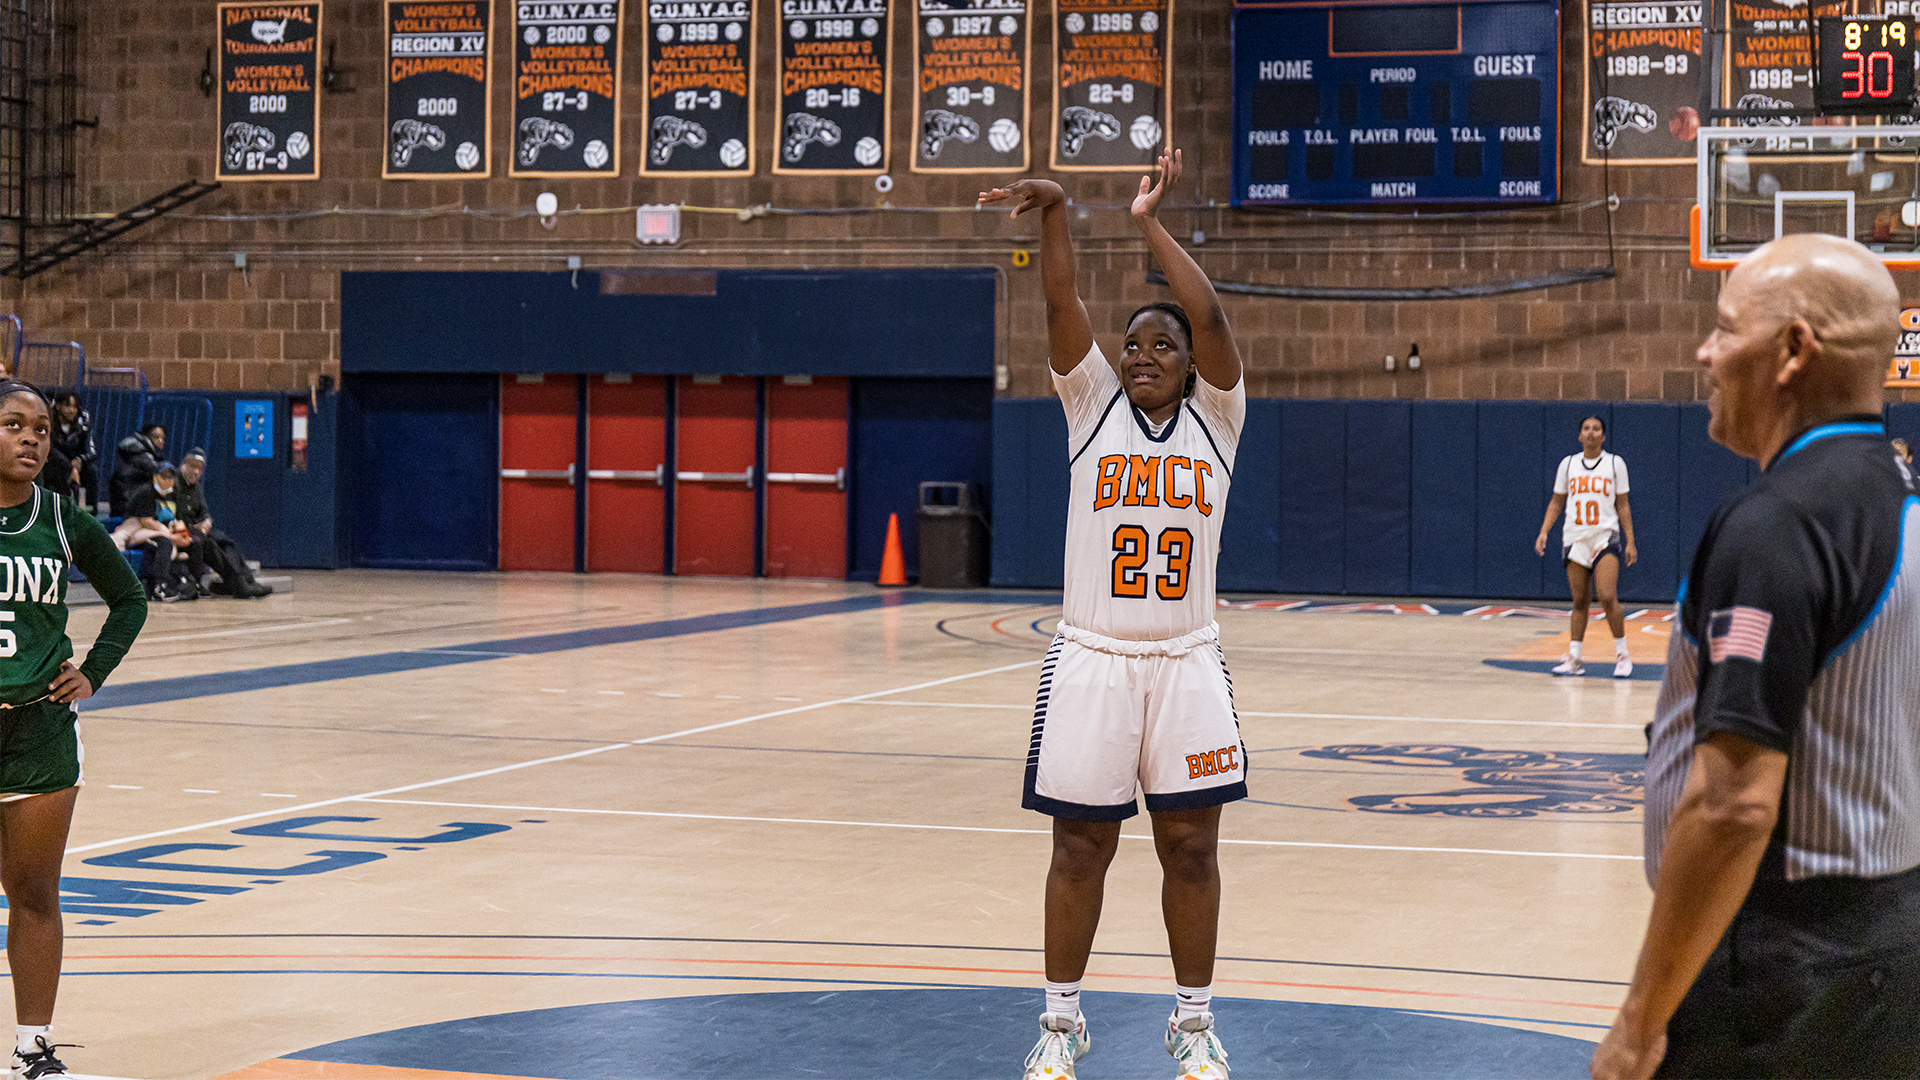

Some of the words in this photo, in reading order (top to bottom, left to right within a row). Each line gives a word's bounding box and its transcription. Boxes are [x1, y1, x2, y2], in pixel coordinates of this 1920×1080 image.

[226, 6, 313, 27] NATIONAL
[403, 4, 476, 18] WOMEN'S
[518, 4, 616, 19] C.U.N.Y.A.C.
[649, 2, 750, 18] C.U.N.Y.A.C.
[1592, 6, 1667, 24] REGION
[1675, 5, 1702, 22] XV
[394, 18, 483, 32] VOLLEYBALL
[814, 19, 854, 38] 1998
[951, 16, 992, 35] 1997
[1092, 13, 1133, 32] 1996
[546, 26, 587, 44] 2000
[680, 23, 718, 41] 1999
[226, 37, 314, 55] TOURNAMENT
[392, 37, 455, 52] REGION
[461, 36, 484, 51] XV
[661, 44, 737, 58] WOMEN'S
[794, 41, 872, 55] WOMEN'S
[932, 36, 1011, 51] WOMEN'S
[1592, 28, 1702, 58] CHAMPIONS
[530, 46, 604, 59] WOMEN'S
[923, 51, 1020, 66] VOLLEYBALL
[1062, 48, 1162, 61] VOLLEYBALL
[234, 65, 304, 78] WOMEN'S
[392, 58, 484, 83] CHAMPIONS
[521, 60, 612, 74] VOLLEYBALL
[652, 59, 745, 73] VOLLEYBALL
[785, 56, 881, 70] VOLLEYBALL
[1259, 60, 1313, 80] HOME
[1473, 55, 1536, 76] GUEST
[1607, 54, 1688, 76] 1992-93
[783, 69, 882, 95] CHAMPIONS
[920, 66, 1021, 92] CHAMPIONS
[1060, 62, 1162, 88] CHAMPIONS
[1370, 68, 1416, 83] PERIOD
[1841, 51, 1893, 98] 30
[227, 78, 311, 92] VOLLEYBALL
[518, 74, 613, 99] CHAMPIONS
[650, 73, 746, 99] CHAMPIONS
[249, 95, 287, 113] 2000
[543, 91, 588, 111] 27-3
[674, 90, 721, 110] 27-3
[805, 87, 861, 107] 20-16
[417, 98, 457, 116] 2000
[1248, 130, 1290, 146] FOULS
[1304, 129, 1339, 145] T.O.L.
[1350, 128, 1398, 144] PLAYER
[1405, 127, 1438, 143] FOUL
[1450, 127, 1486, 142] T.O.L.
[1500, 126, 1541, 142] FOULS
[246, 151, 288, 170] 27-3
[1248, 184, 1289, 199] SCORE
[1371, 182, 1416, 198] MATCH
[1499, 181, 1541, 197] SCORE
[1093, 454, 1214, 518] BMCC
[1574, 500, 1600, 526] 10
[1111, 524, 1194, 600] 23
[1185, 744, 1239, 780] BMCC
